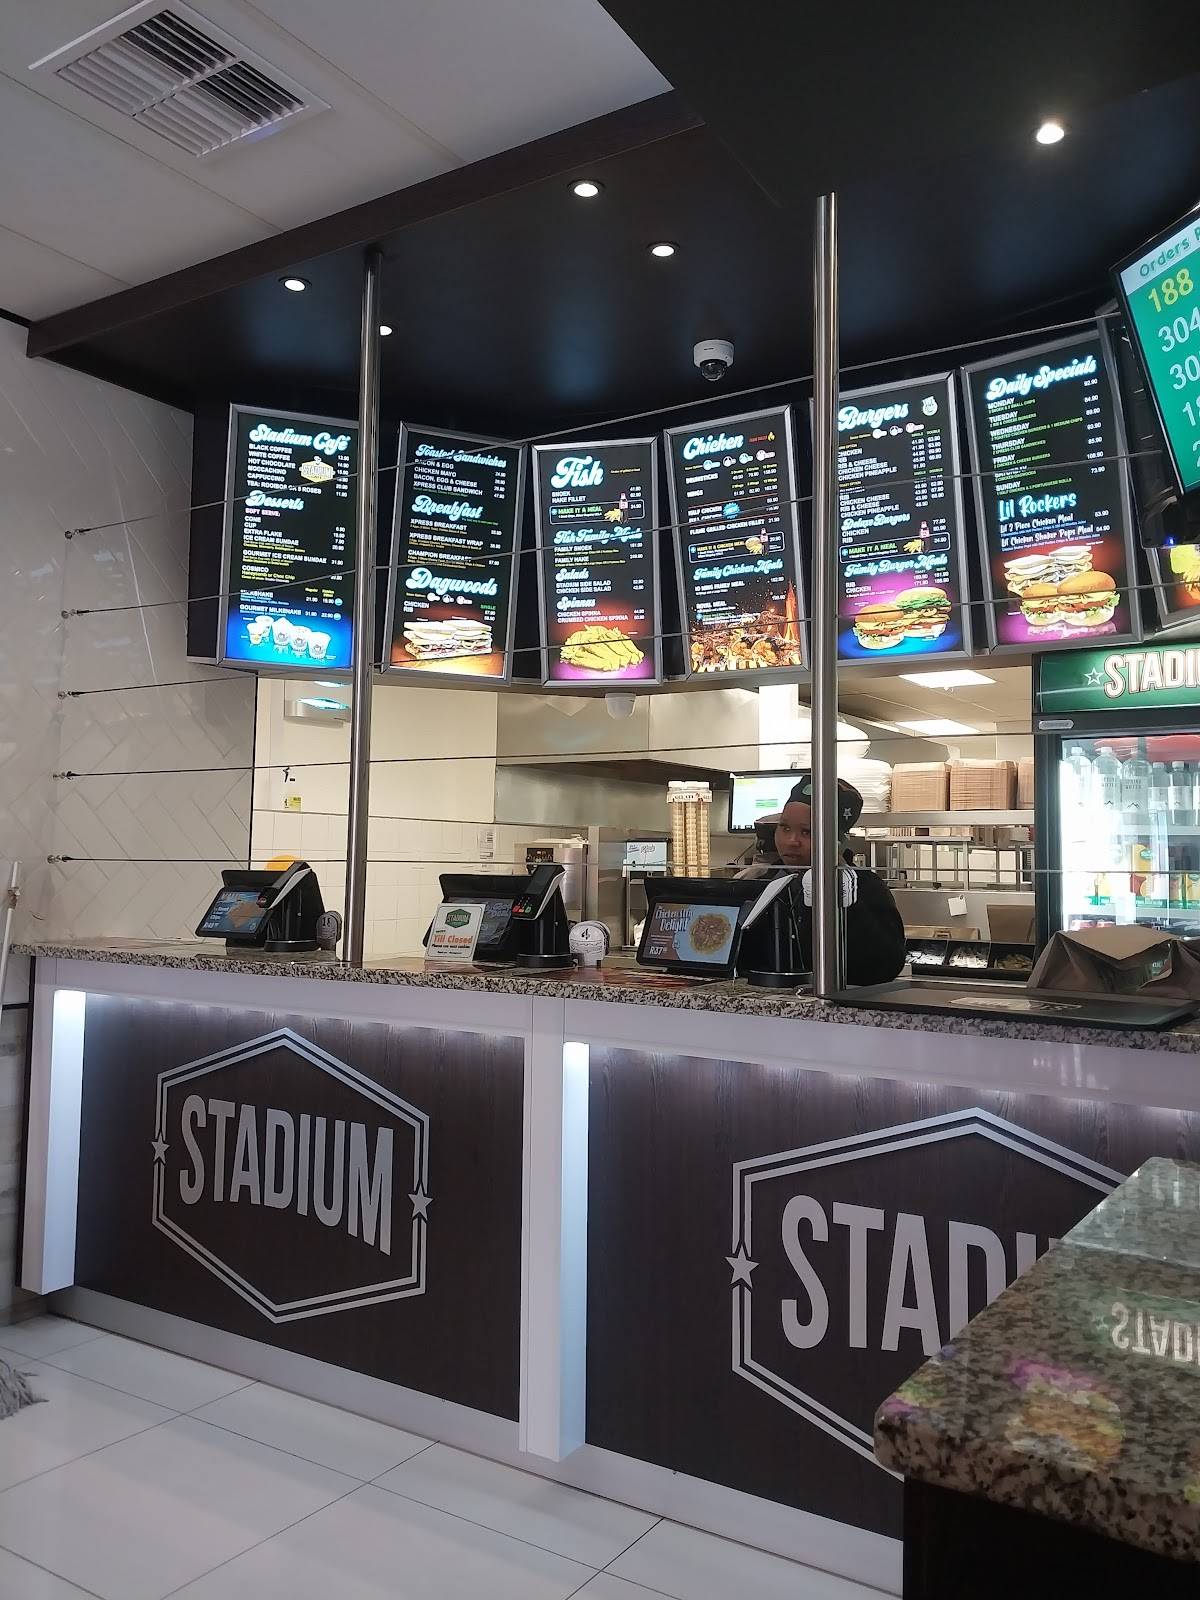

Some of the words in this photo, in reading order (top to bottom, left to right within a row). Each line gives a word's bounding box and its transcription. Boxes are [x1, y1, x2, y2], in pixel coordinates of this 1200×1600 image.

[1140, 238, 1191, 277] Orders
[1148, 268, 1194, 313] 188
[1158, 306, 1200, 352] 304
[986, 373, 1034, 400] Daily
[1032, 355, 1097, 389] Specials
[1169, 352, 1200, 390] 30
[987, 397, 1015, 410] MONDAY
[838, 403, 909, 432] Burgers
[988, 410, 1019, 423] TUESDAY
[249, 423, 313, 447] Stadium
[989, 422, 1030, 437] WEDNESDAY
[249, 443, 269, 452] BLACK
[270, 445, 293, 454] COFFEE
[683, 432, 744, 460] Chicken
[991, 437, 1026, 450] THURSDAY
[248, 451, 267, 459] WHITE
[267, 453, 291, 461] COFFEE
[415, 444, 454, 460] Toasted
[453, 450, 507, 468] Sandwiches
[853, 457, 878, 467] CHEESE
[992, 454, 1016, 465] FRIDAY
[262, 459, 296, 469] CHOCOLATE
[441, 462, 454, 470] EGG
[838, 466, 864, 475] CHICKEN
[864, 462, 888, 471] CHEESE
[247, 473, 285, 482] CAPPUCCINO
[414, 466, 440, 476] CHICKEN
[440, 470, 457, 478] MAYO
[550, 455, 604, 489] Fish
[838, 472, 864, 481] CHICKEN
[865, 466, 898, 477] PINEAPPLE
[413, 481, 436, 489] XPRESS
[436, 484, 452, 492] CLUB
[452, 486, 483, 496] SANDWICH
[436, 476, 449, 484] EGG
[454, 479, 478, 488] CHEESE
[995, 480, 1021, 491] SUNDAY
[245, 490, 304, 510] Desserts
[840, 497, 866, 507] CHICKEN
[866, 493, 890, 502] CHEESE
[411, 495, 483, 521] Breakfast
[840, 505, 851, 513] RIB
[856, 501, 880, 509] CHEESE
[841, 508, 867, 519] CHICKEN
[867, 504, 900, 515] PINEAPPLE
[999, 499, 1015, 522] Lil
[1018, 492, 1078, 518] Rockers
[410, 518, 434, 527] XPRESS
[433, 521, 468, 531] BREAKFAST
[726, 521, 748, 530] CHICKEN
[874, 513, 911, 526] Burgers
[1009, 523, 1014, 532] 2
[1014, 522, 1031, 531] Piece
[1031, 517, 1056, 528] Chicken
[1057, 513, 1074, 524] Meal
[243, 528, 263, 536] EXTRA
[263, 530, 283, 538] FLAKE
[409, 532, 432, 541] XPRESS
[432, 534, 467, 545] BREAKFAST
[466, 539, 484, 547] WRAP
[553, 530, 576, 544] Fish
[575, 529, 611, 544] Family
[842, 528, 870, 538] CHICKEN
[1010, 535, 1034, 546] Chicken
[1035, 532, 1057, 542] Shaker
[1058, 529, 1076, 539] Pops
[1077, 524, 1094, 535] Meal
[254, 536, 275, 544] CREAM
[842, 536, 853, 544] RIB
[407, 549, 439, 559] CHAMPION
[848, 546, 866, 555] MAKE
[866, 545, 873, 553] IT
[880, 542, 898, 551] MEAL
[242, 549, 272, 559] GOURMET
[282, 553, 303, 562] CREAM
[693, 567, 722, 581] Family
[722, 563, 755, 577] Chicken
[754, 558, 783, 574] Meals
[844, 562, 879, 577] Family
[878, 559, 915, 573] Burger
[914, 553, 948, 570] Meals
[405, 567, 498, 596] Dagwoods
[555, 568, 590, 582] Salads
[845, 585, 872, 594] CHICKEN
[403, 600, 430, 609] CHICKEN
[584, 615, 609, 623] CHICKEN
[1103, 648, 1200, 699] STADI
[433, 934, 446, 944] Till
[447, 934, 474, 945] Closed
[180, 1094, 394, 1256] STADIUM
